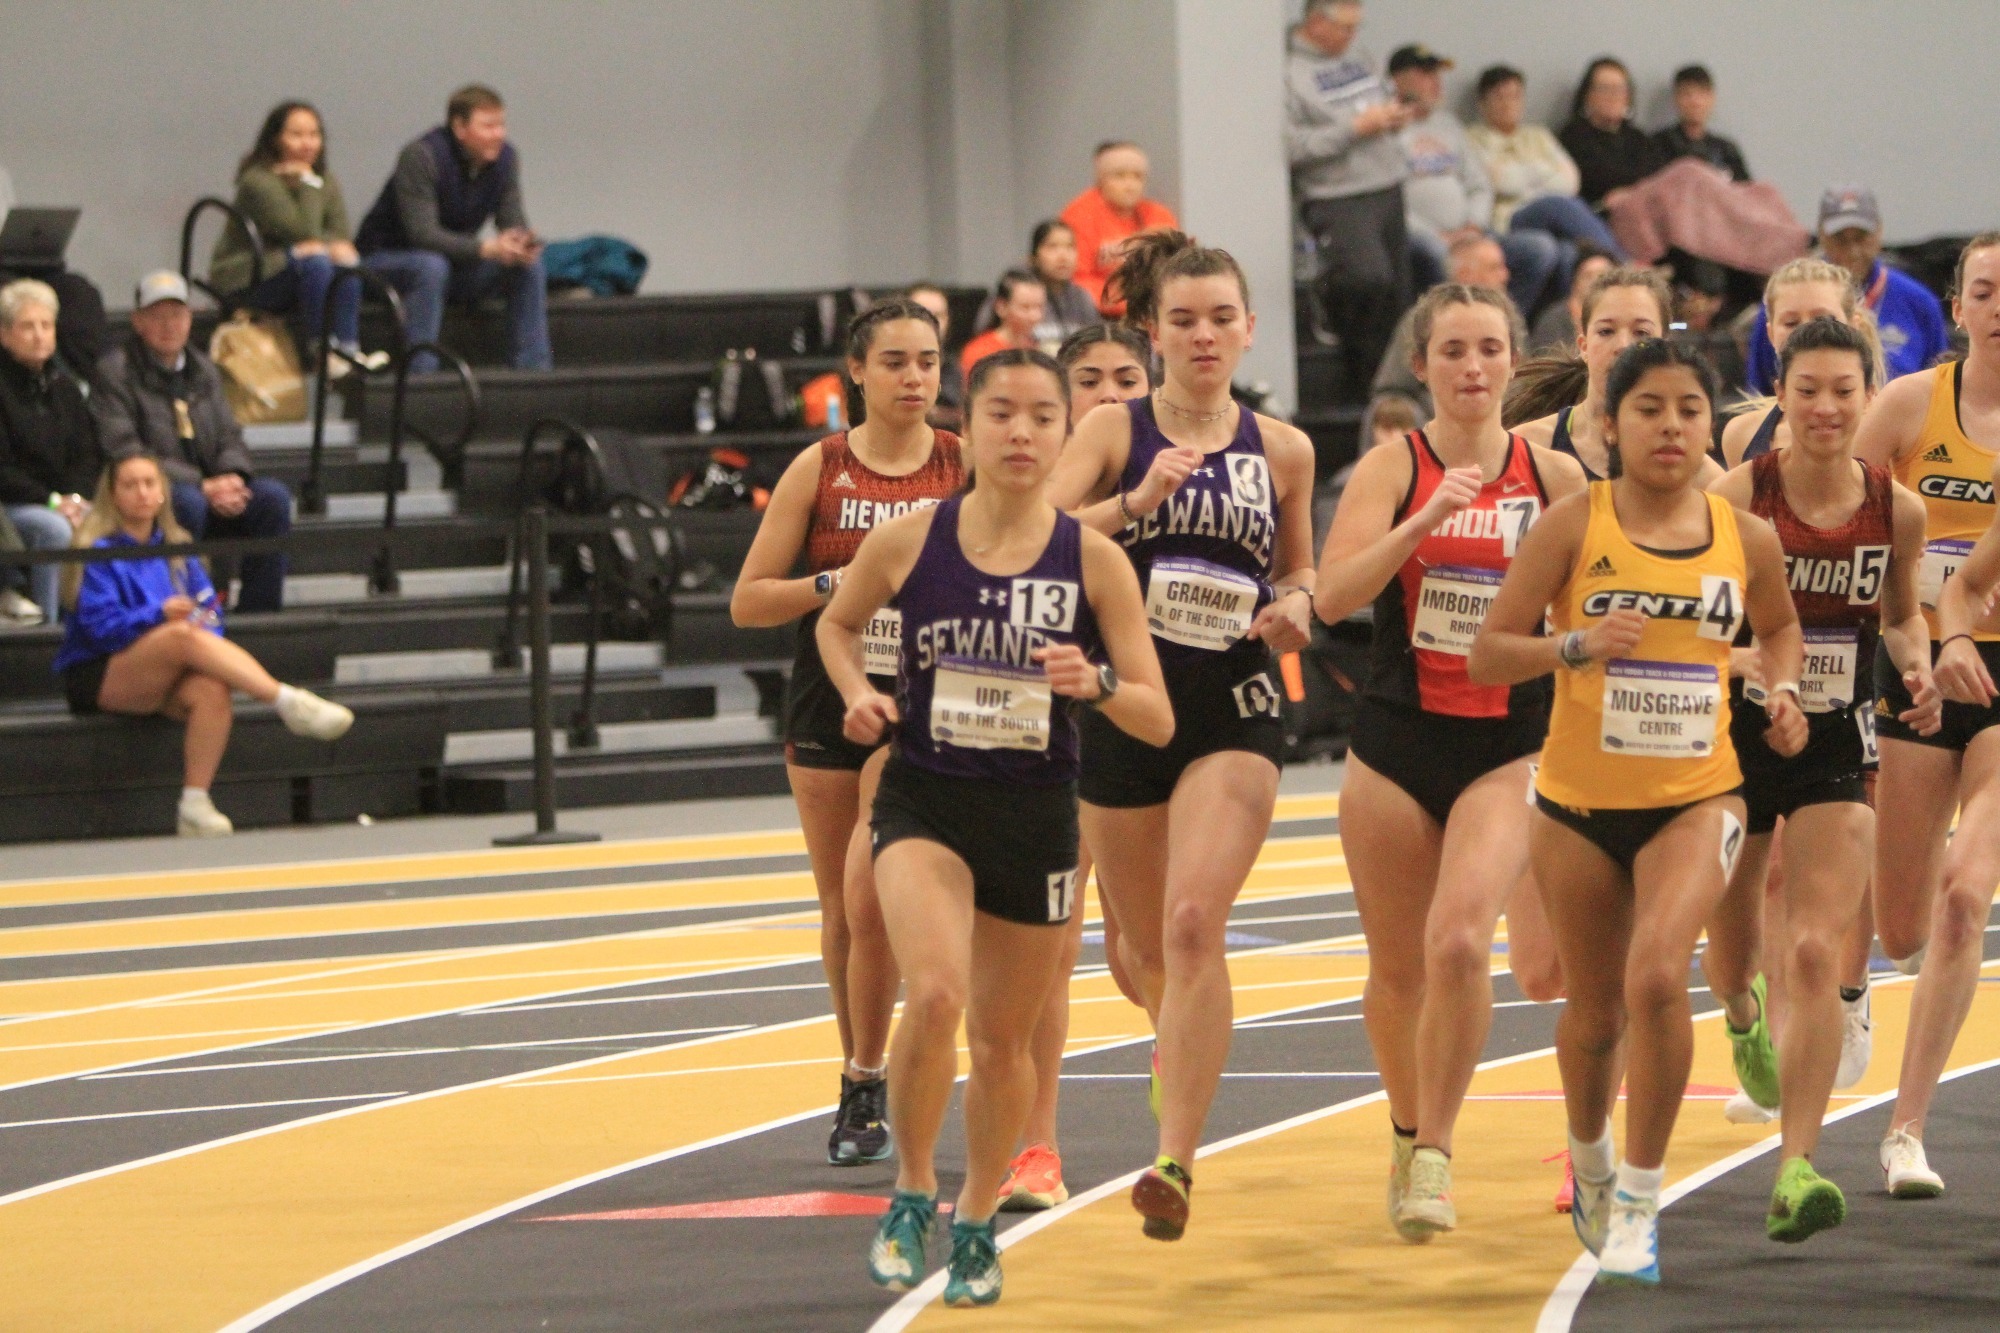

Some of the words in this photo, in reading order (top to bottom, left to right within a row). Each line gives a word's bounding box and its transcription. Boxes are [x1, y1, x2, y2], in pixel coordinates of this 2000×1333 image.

[1235, 458, 1266, 506] 8
[1920, 477, 1994, 501] CEN
[1431, 509, 1503, 539] HOD
[1502, 501, 1534, 550] 7
[1783, 555, 1851, 595] NDR
[1857, 549, 1885, 601] 5
[1018, 583, 1067, 628] 13
[1167, 581, 1240, 613] GRAHAM
[1422, 588, 1494, 617] IMBORN
[1706, 581, 1735, 636] 4
[1169, 608, 1183, 622] OF
[1186, 611, 1202, 626] THE
[1204, 614, 1242, 632] SOUTH
[1450, 620, 1481, 636] RHOD
[864, 642, 899, 657] ENDRI
[917, 618, 1056, 670] SEWANE
[976, 687, 1012, 711] UDE
[1800, 680, 1825, 693] DRIX
[1611, 689, 1713, 715] MUSGRAVE
[957, 711, 972, 726] OF
[976, 714, 996, 729] THE
[1000, 717, 1040, 731] SOUTH
[1639, 720, 1683, 736] CENTRE
